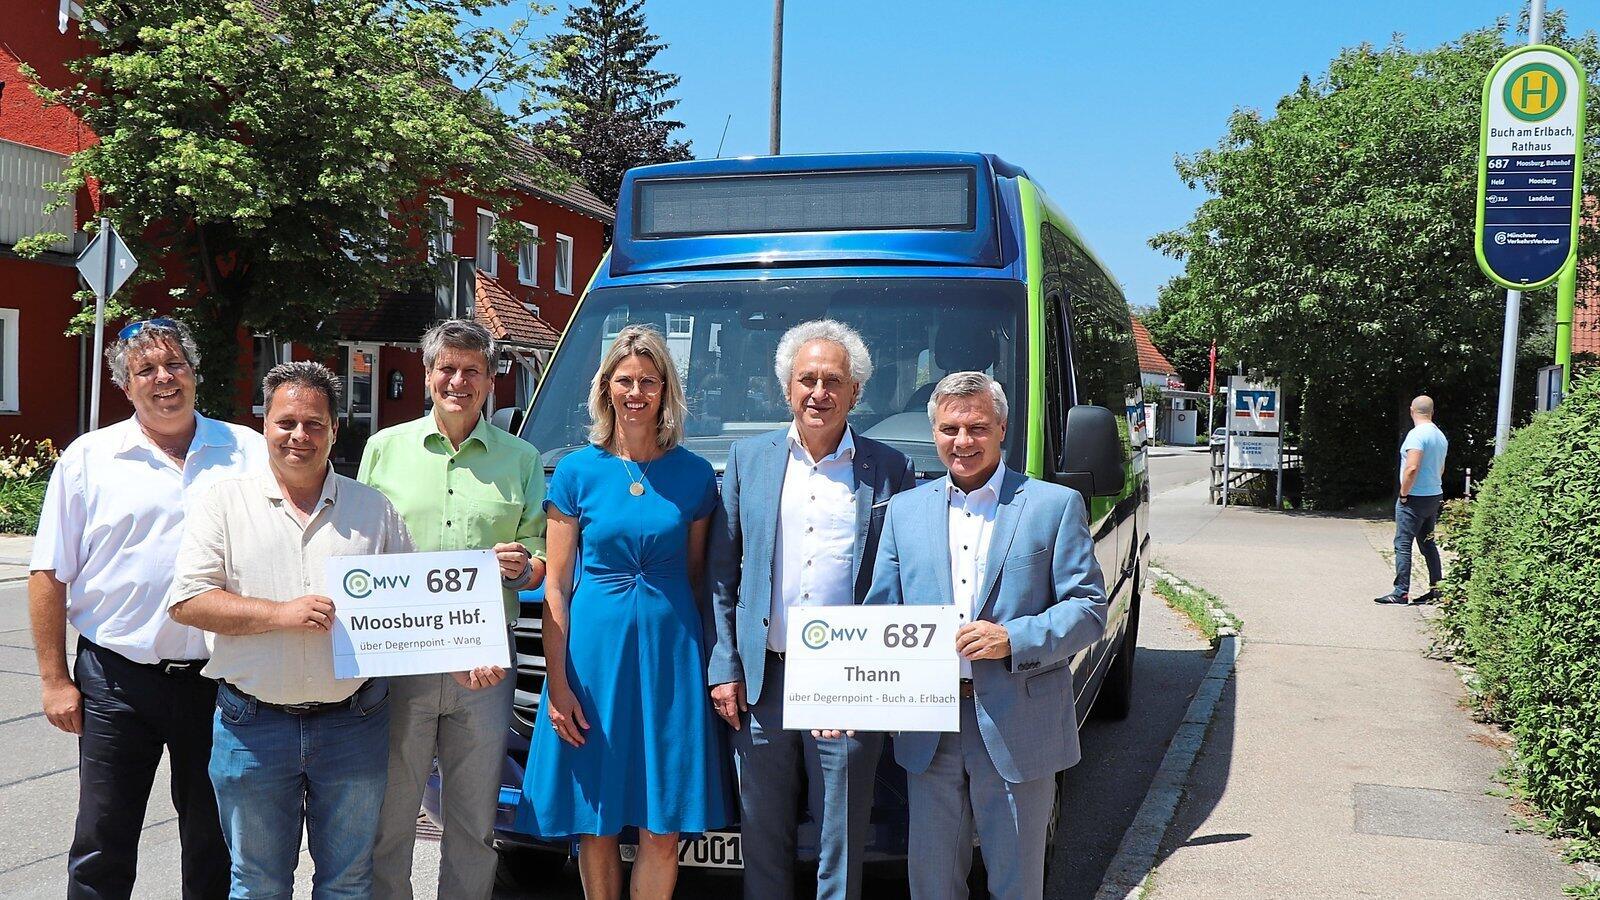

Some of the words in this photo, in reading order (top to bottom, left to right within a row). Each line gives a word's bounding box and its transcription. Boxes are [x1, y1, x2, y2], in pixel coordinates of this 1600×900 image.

[1521, 75, 1548, 109] H
[1491, 128, 1515, 137] Buch
[1517, 129, 1532, 137] am
[1534, 127, 1575, 137] Erlbach,
[1512, 142, 1552, 151] Rathaus
[1488, 159, 1510, 169] 687
[373, 575, 411, 590] MVV
[426, 567, 478, 594] 687
[350, 613, 443, 631] Moosburg
[449, 608, 486, 625] Hbf.
[360, 641, 382, 651] über
[385, 639, 445, 652] Degernpoint
[453, 635, 482, 646] Wang
[831, 628, 868, 641] MVV
[883, 623, 937, 648] 687
[844, 666, 901, 682] Thann
[789, 693, 811, 702] über
[813, 693, 873, 704] Degernpoint
[882, 693, 906, 703] Buch
[920, 694, 956, 703] Erlbach
